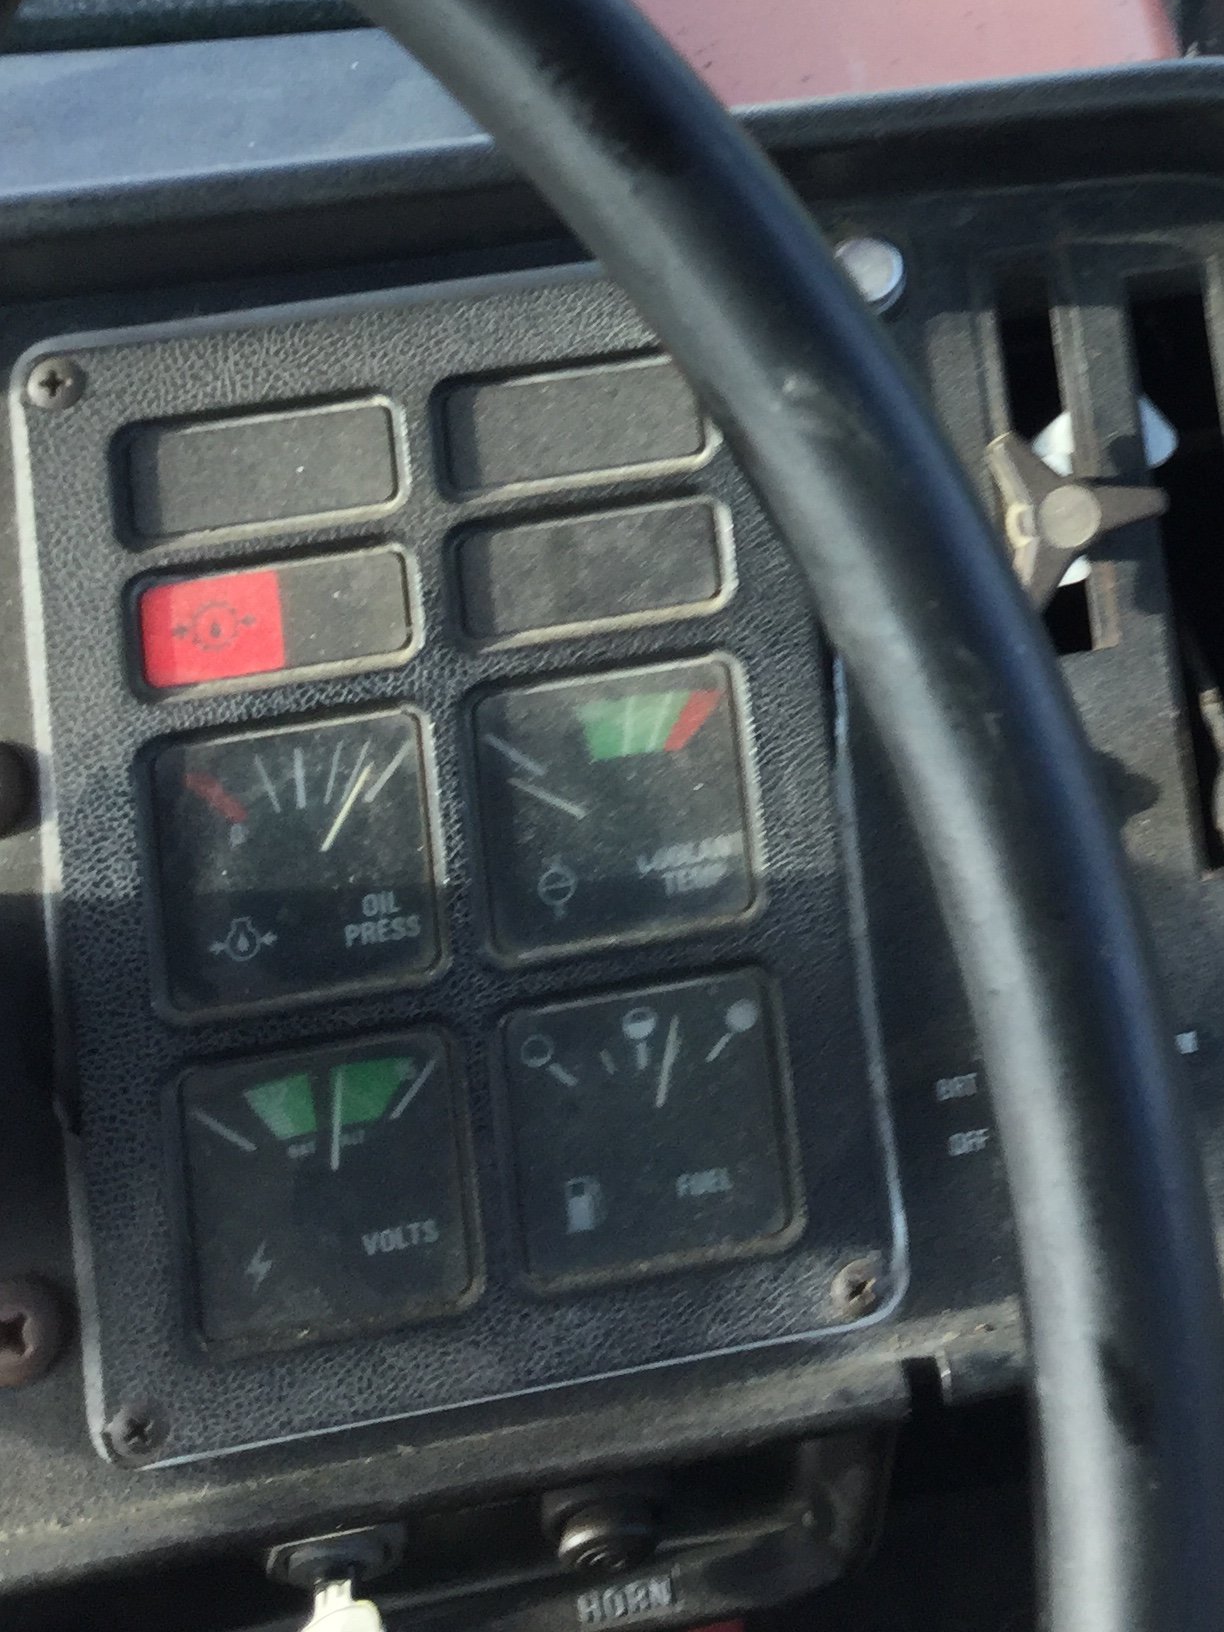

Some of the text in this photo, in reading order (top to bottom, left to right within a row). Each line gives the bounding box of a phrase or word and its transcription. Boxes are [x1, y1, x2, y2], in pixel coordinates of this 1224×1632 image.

[362, 890, 401, 917] OIL
[344, 915, 421, 948] PRESS
[362, 1219, 440, 1256] VOLTS
[577, 1575, 672, 1625] HORN
